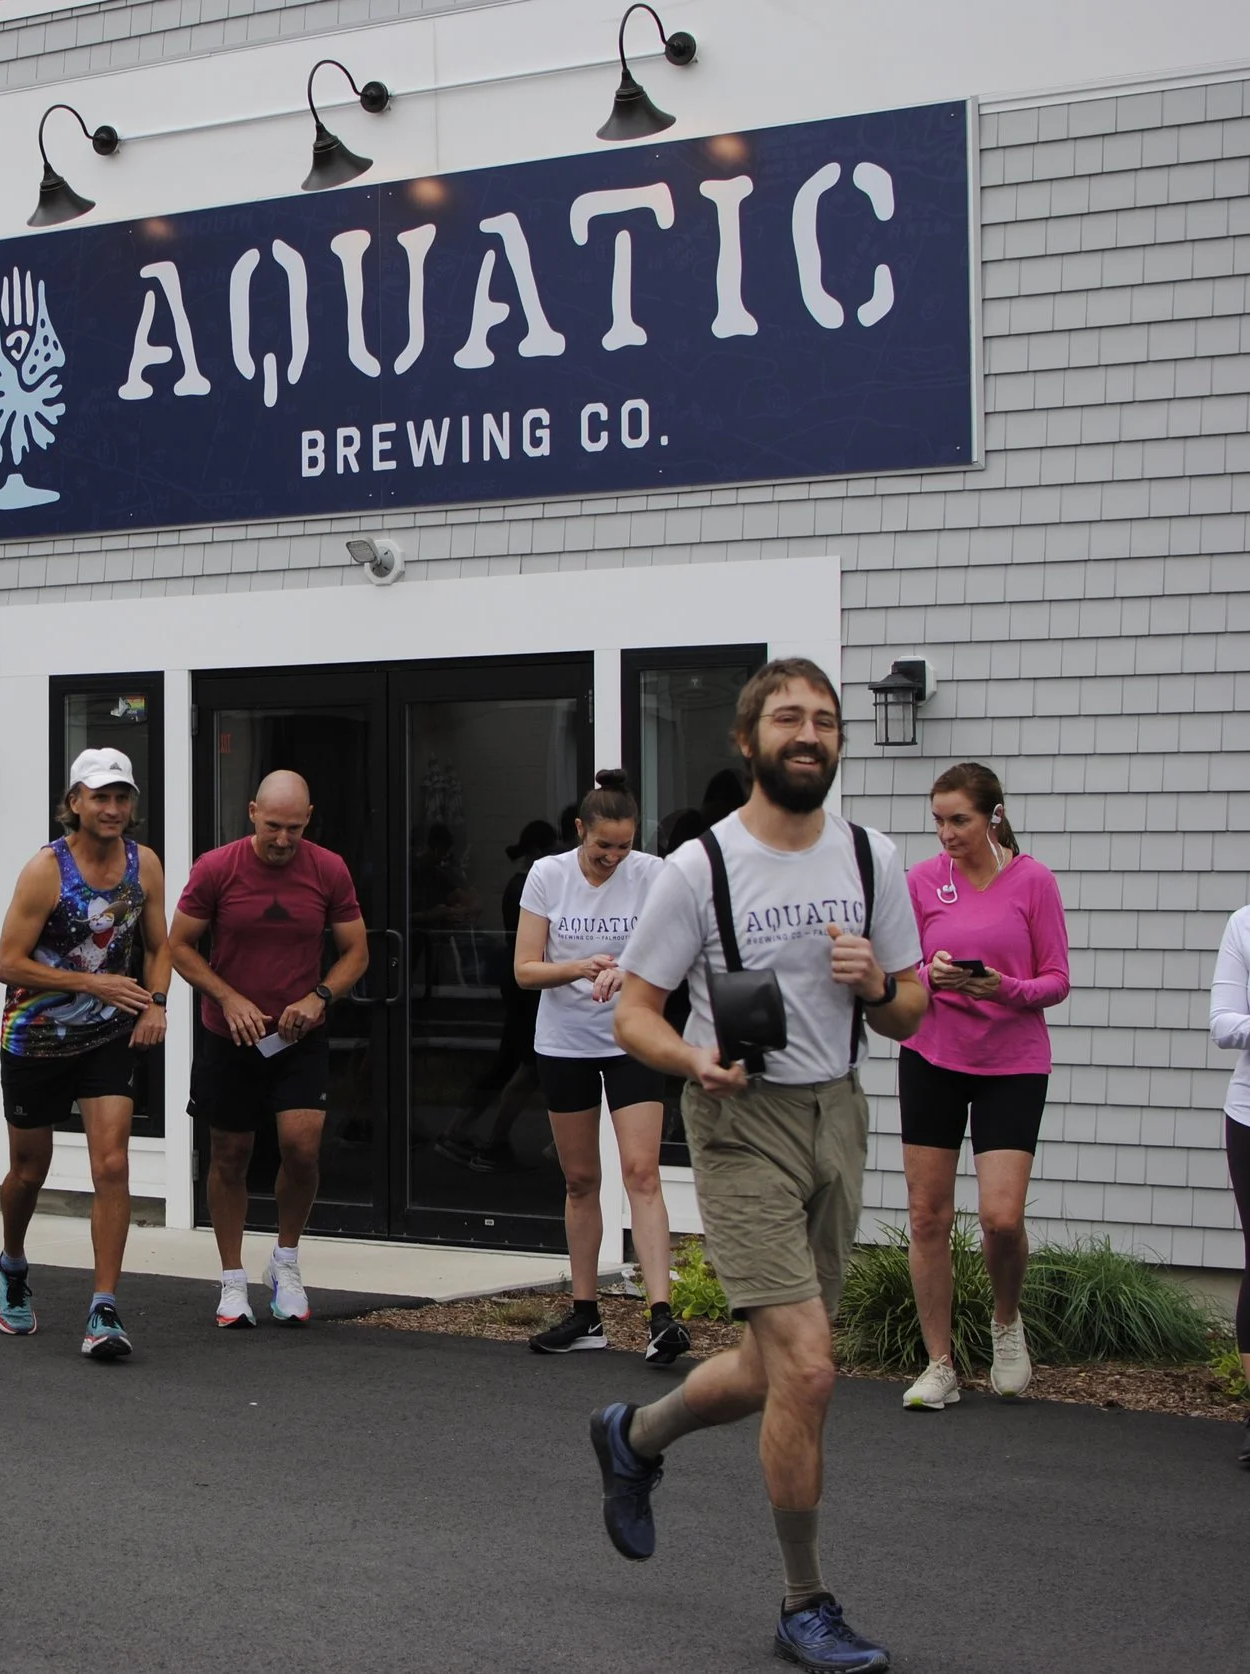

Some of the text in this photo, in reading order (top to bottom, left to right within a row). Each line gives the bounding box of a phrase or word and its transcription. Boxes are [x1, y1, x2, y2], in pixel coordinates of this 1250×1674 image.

[117, 161, 895, 408] AQUATIC
[301, 398, 670, 478] BREWING CO.
[558, 915, 638, 933] AQUATIC
[746, 900, 863, 933] AQUATIC
[557, 933, 583, 941] BREWING
[746, 933, 789, 946] BREWING
